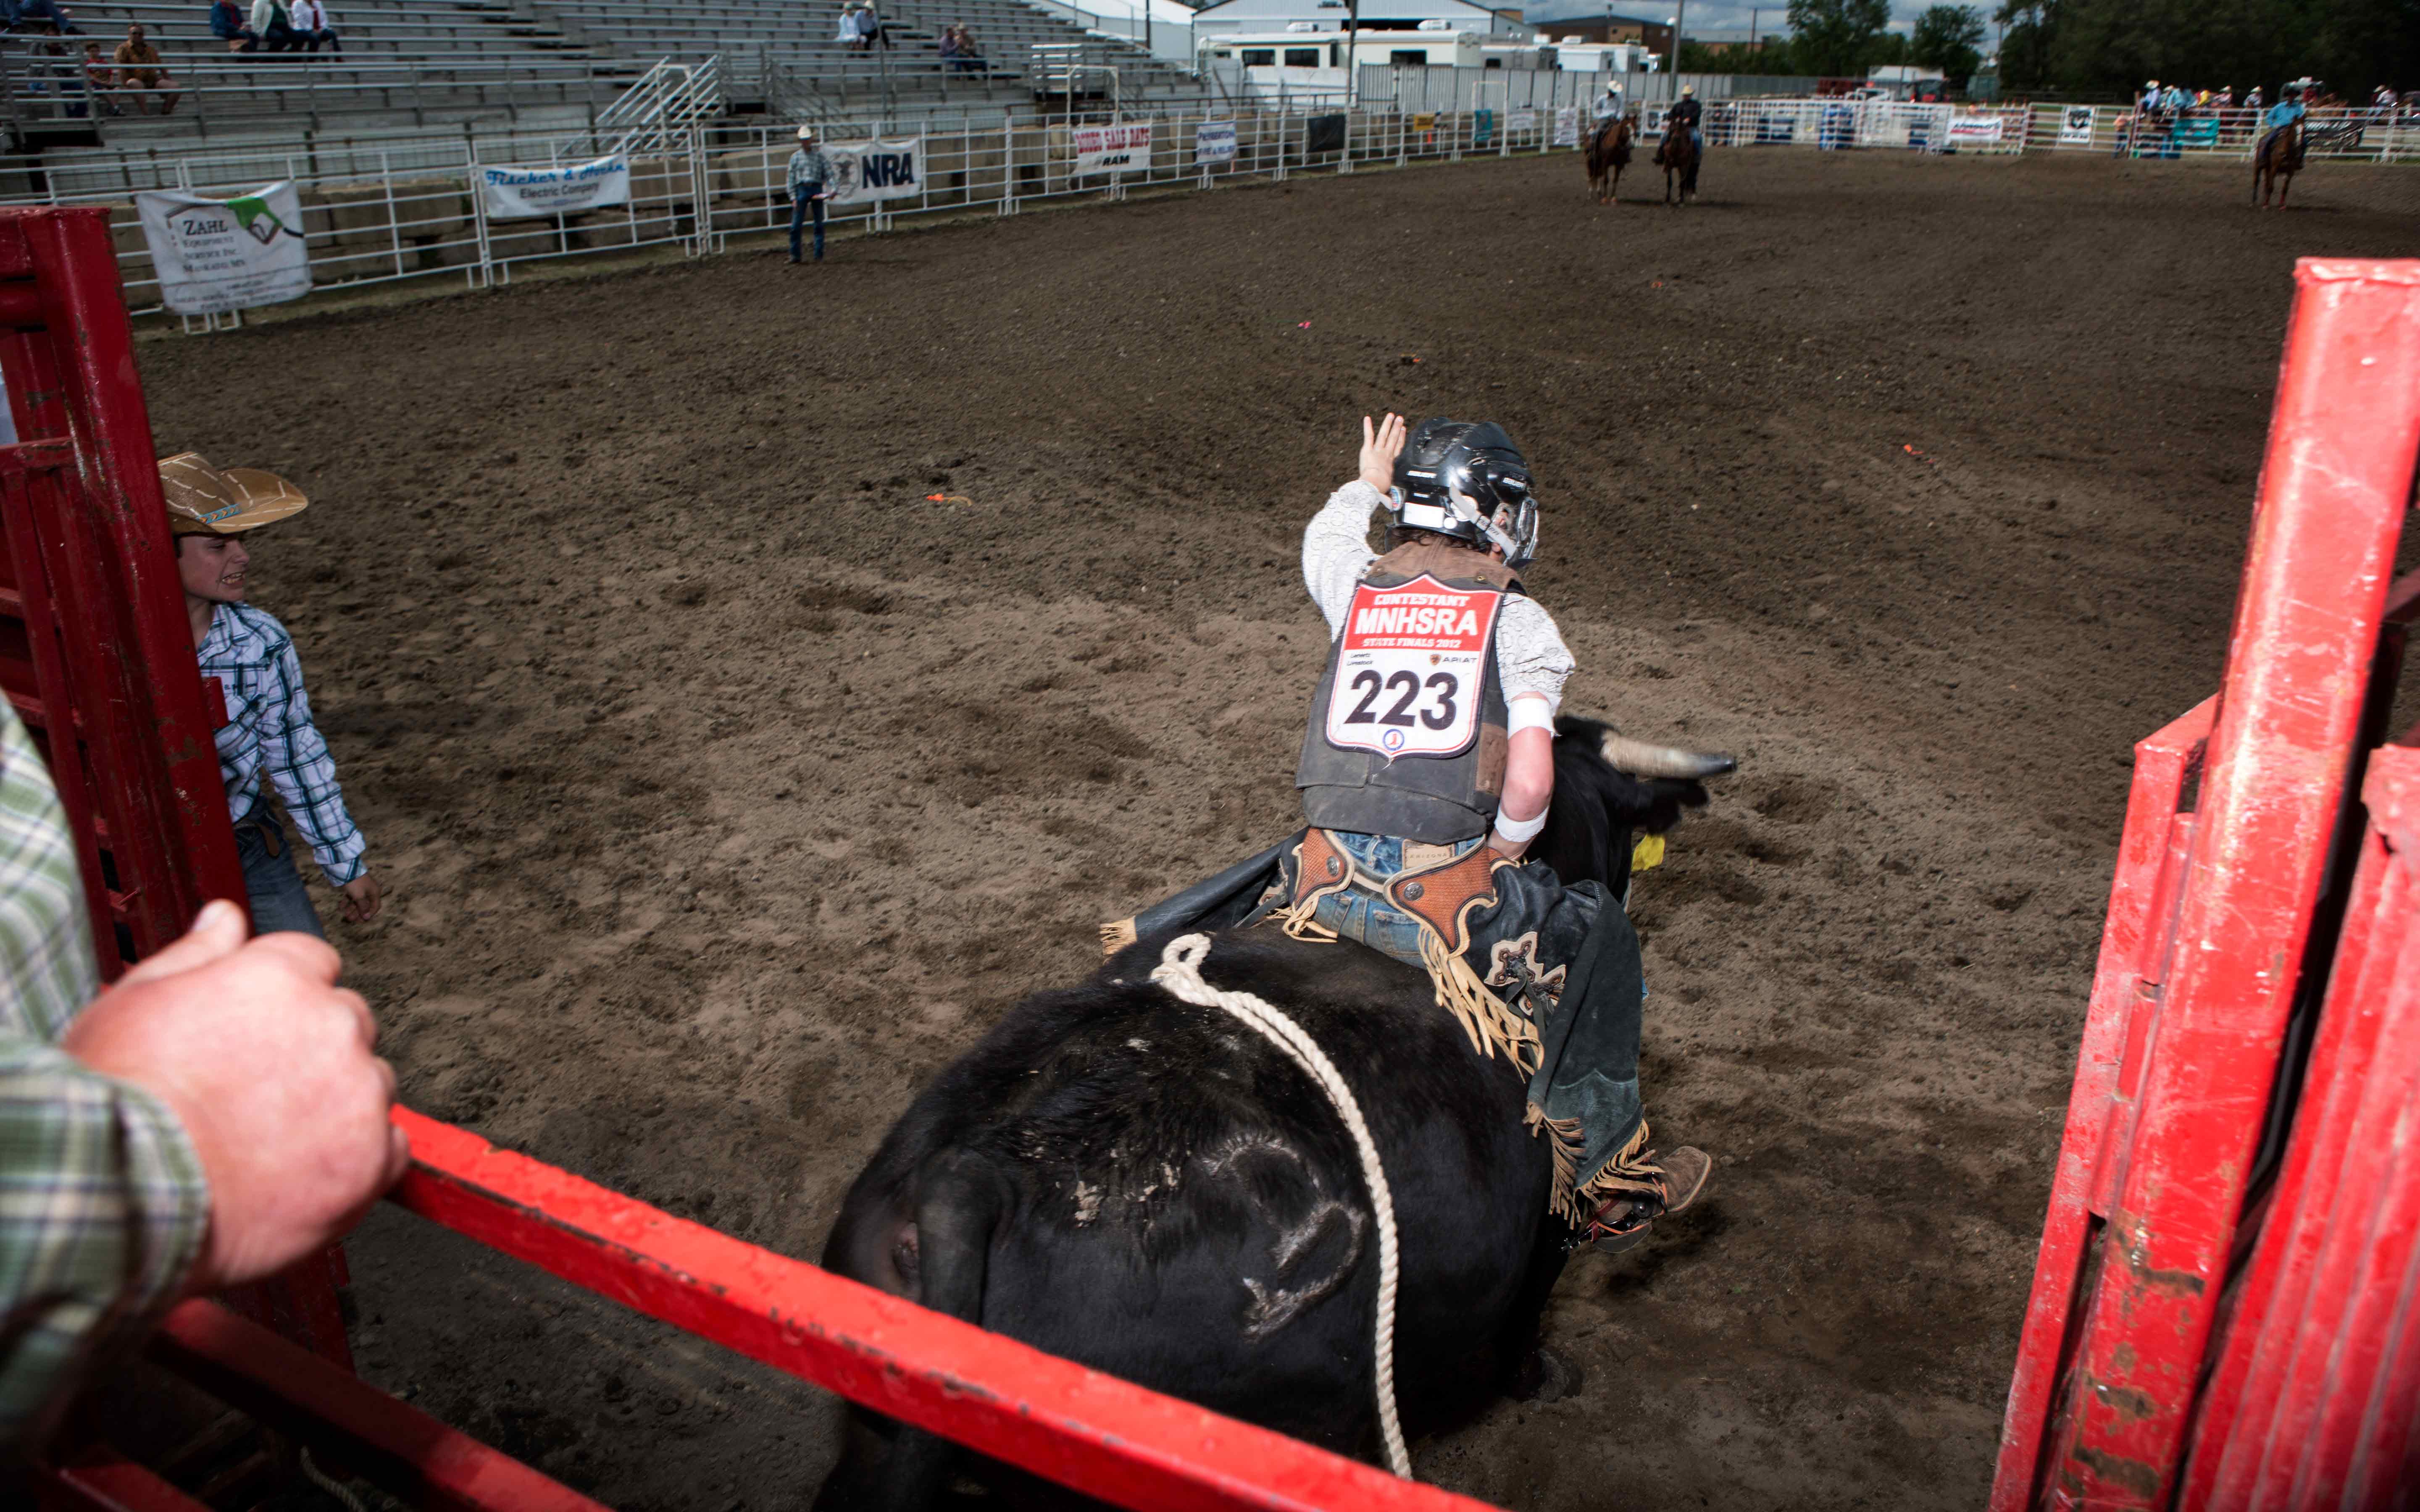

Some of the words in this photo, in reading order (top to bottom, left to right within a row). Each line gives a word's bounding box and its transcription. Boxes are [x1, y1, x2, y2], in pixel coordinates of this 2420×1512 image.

[1105, 129, 1126, 150] SALE
[1129, 127, 1150, 148] DAYS
[1103, 155, 1130, 166] RAM
[564, 168, 573, 181] &
[862, 152, 915, 189] NRA
[519, 186, 559, 199] Electric
[561, 182, 600, 195] Company
[183, 219, 229, 236] ZAHL
[1374, 593, 1470, 607] CONTESTANT
[1355, 607, 1478, 636] MNHSRA
[1362, 637, 1395, 647] STATE
[1396, 638, 1435, 648] FINALS
[1435, 638, 1462, 649] 2012
[1343, 669, 1459, 730] 223
